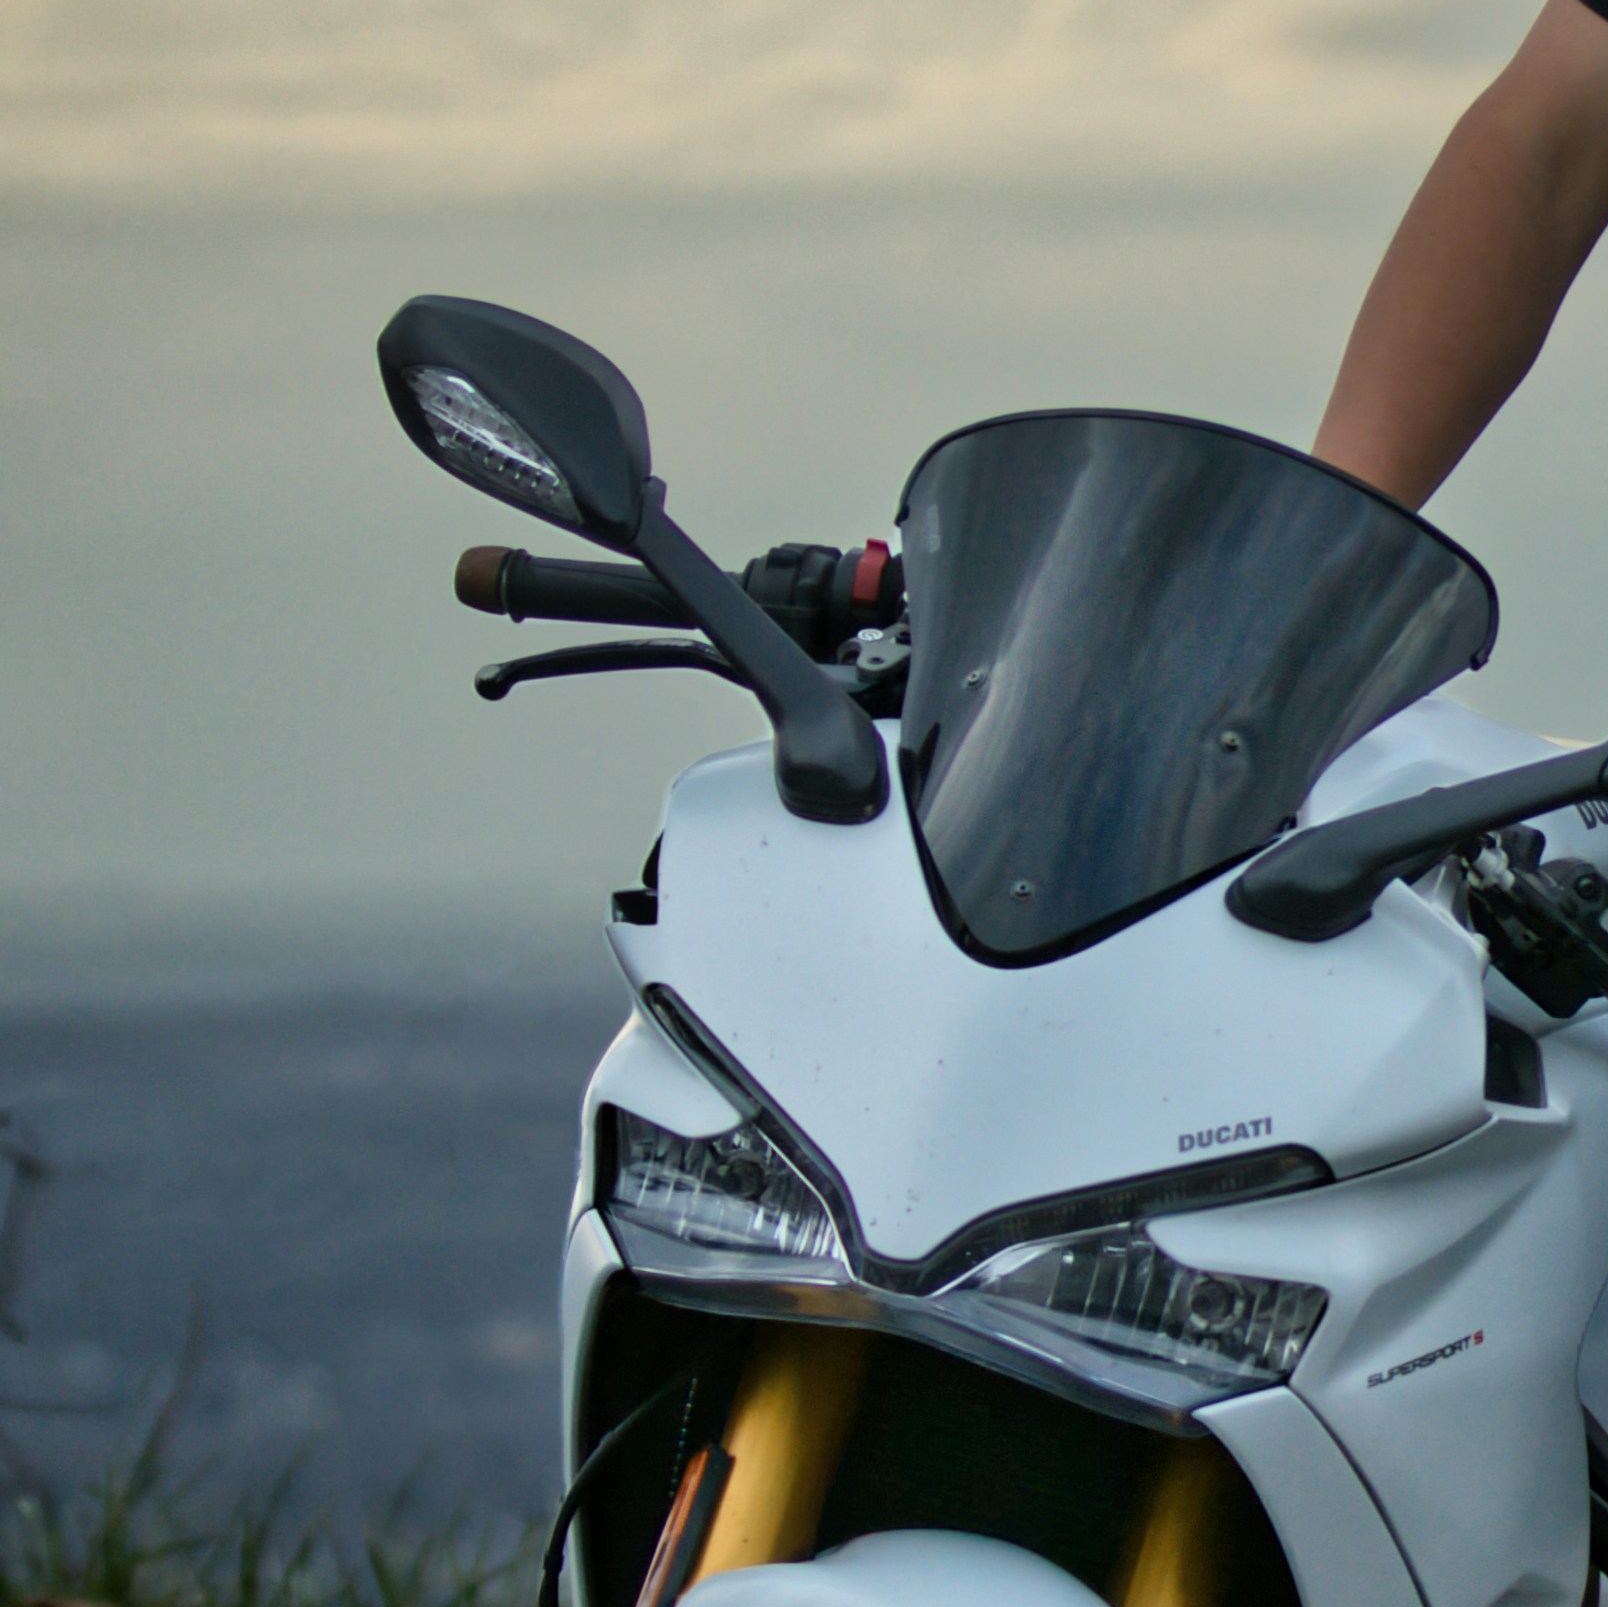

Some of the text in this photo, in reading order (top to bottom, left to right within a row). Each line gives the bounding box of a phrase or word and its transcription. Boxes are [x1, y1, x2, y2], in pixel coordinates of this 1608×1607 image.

[1178, 1116, 1272, 1153] DUCATI
[1367, 1330, 1485, 1388] SUPERSPORT S
